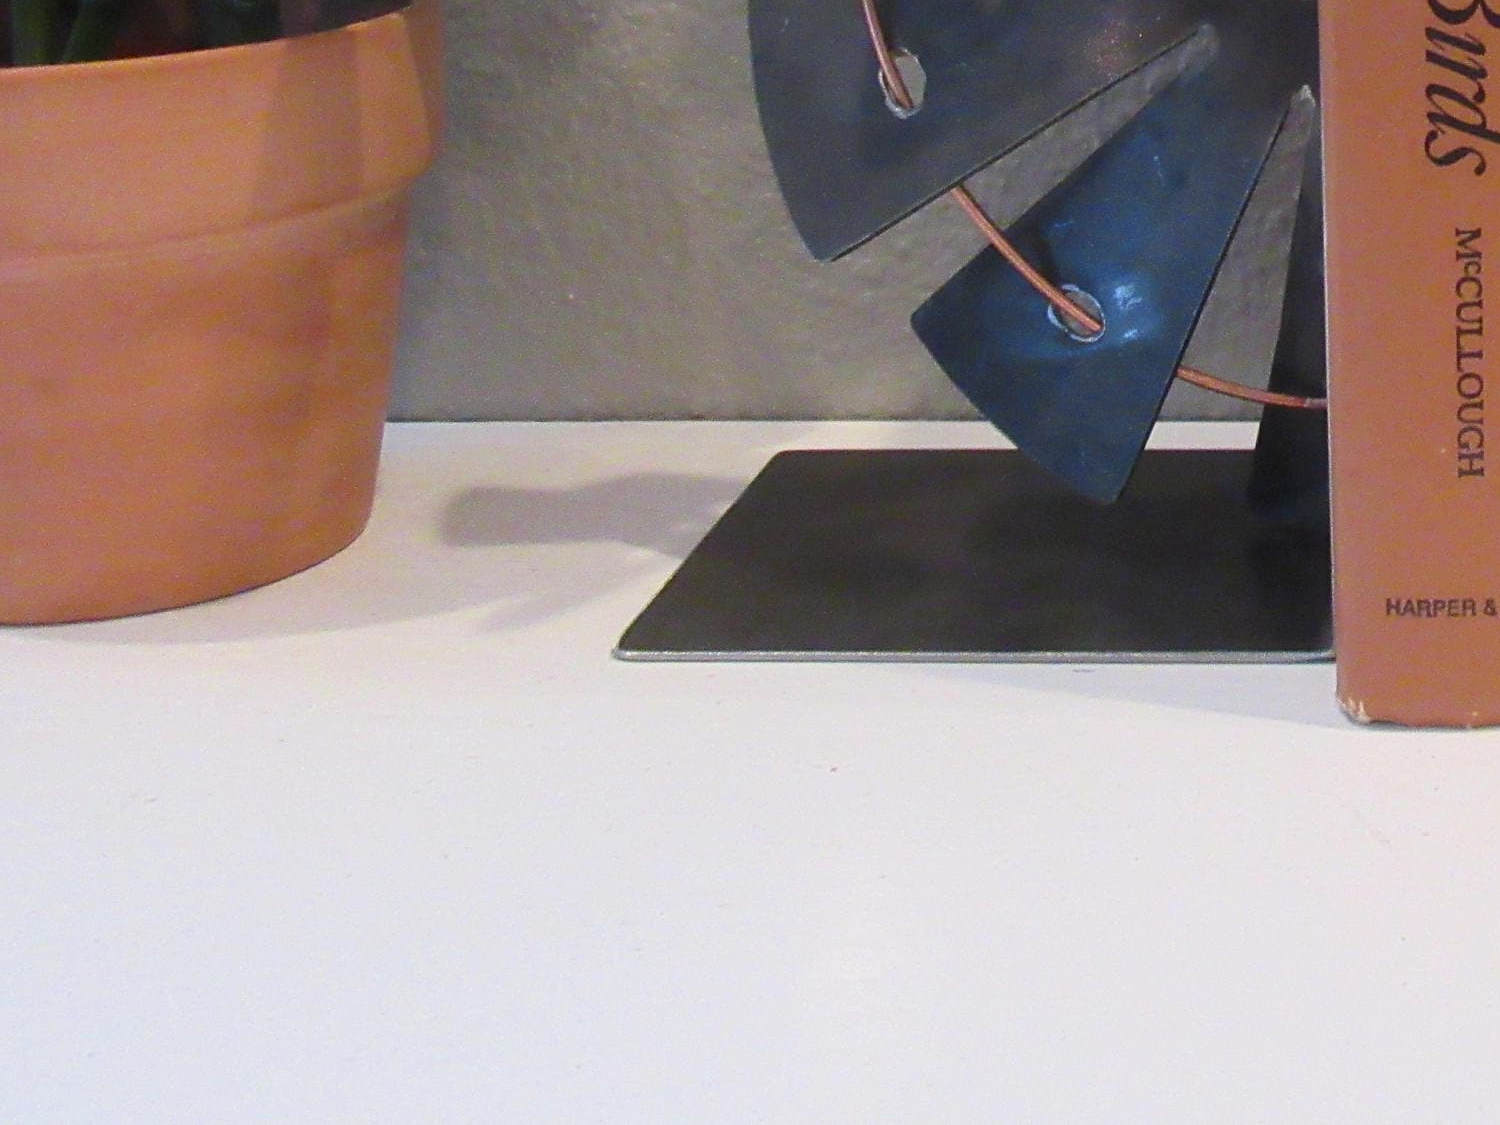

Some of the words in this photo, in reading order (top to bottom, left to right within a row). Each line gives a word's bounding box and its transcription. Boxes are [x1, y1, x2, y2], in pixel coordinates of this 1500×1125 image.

[1454, 227, 1486, 479] McCULLOUGH
[1384, 597, 1478, 619] HARPER
[1483, 597, 1499, 618] &
